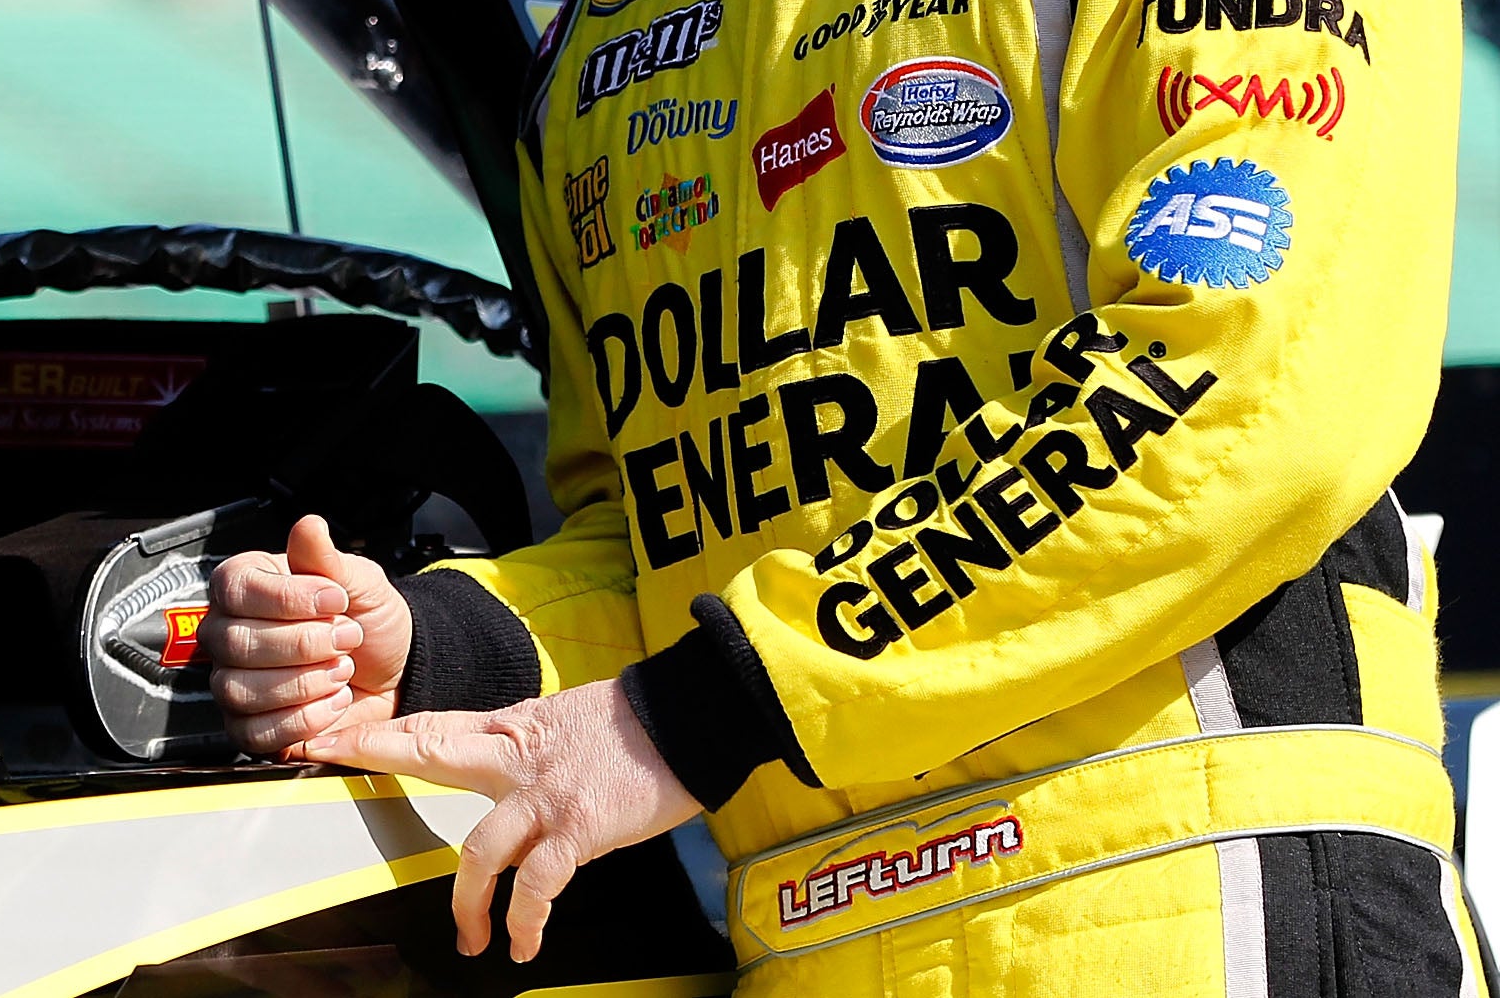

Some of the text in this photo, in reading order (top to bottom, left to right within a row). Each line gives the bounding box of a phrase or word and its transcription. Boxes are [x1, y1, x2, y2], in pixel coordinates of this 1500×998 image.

[626, 99, 739, 155] Downy
[872, 101, 1002, 133] Reynolds Wrap
[759, 127, 834, 175] Hanes
[630, 191, 720, 251] Toast Crunch
[635, 172, 712, 222] Cinnamon
[1138, 192, 1272, 252] ASE
[586, 202, 1037, 442] DOLLAR
[67, 407, 144, 436] Systems
[813, 312, 1129, 576] DOLLAR
[618, 349, 1036, 577] ENERA
[816, 354, 1220, 661] GENERAL
